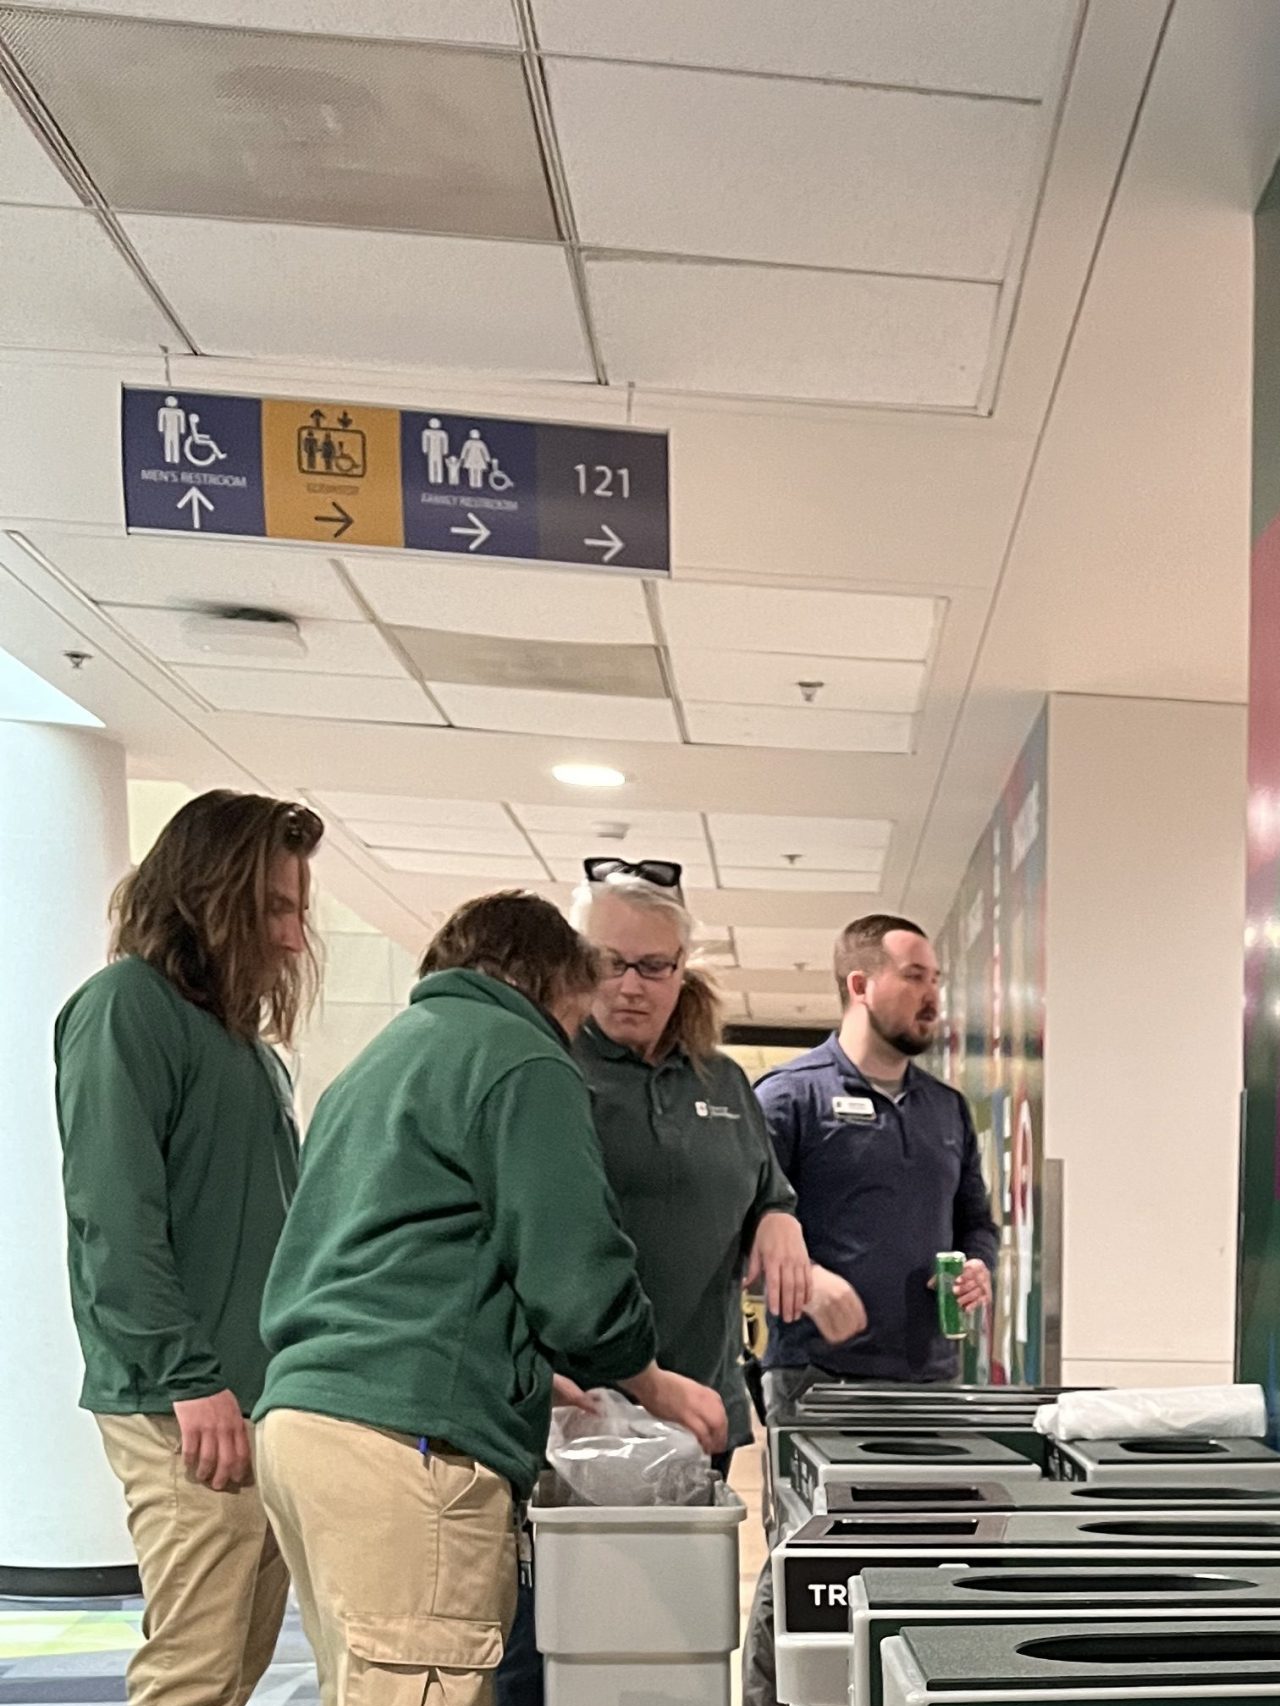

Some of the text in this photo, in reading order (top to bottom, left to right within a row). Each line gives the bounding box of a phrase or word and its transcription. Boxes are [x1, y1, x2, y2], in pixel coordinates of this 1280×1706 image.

[141, 469, 248, 488] MEN'S RESTROOM
[574, 464, 630, 498] 121
[807, 1583, 848, 1607] TR
